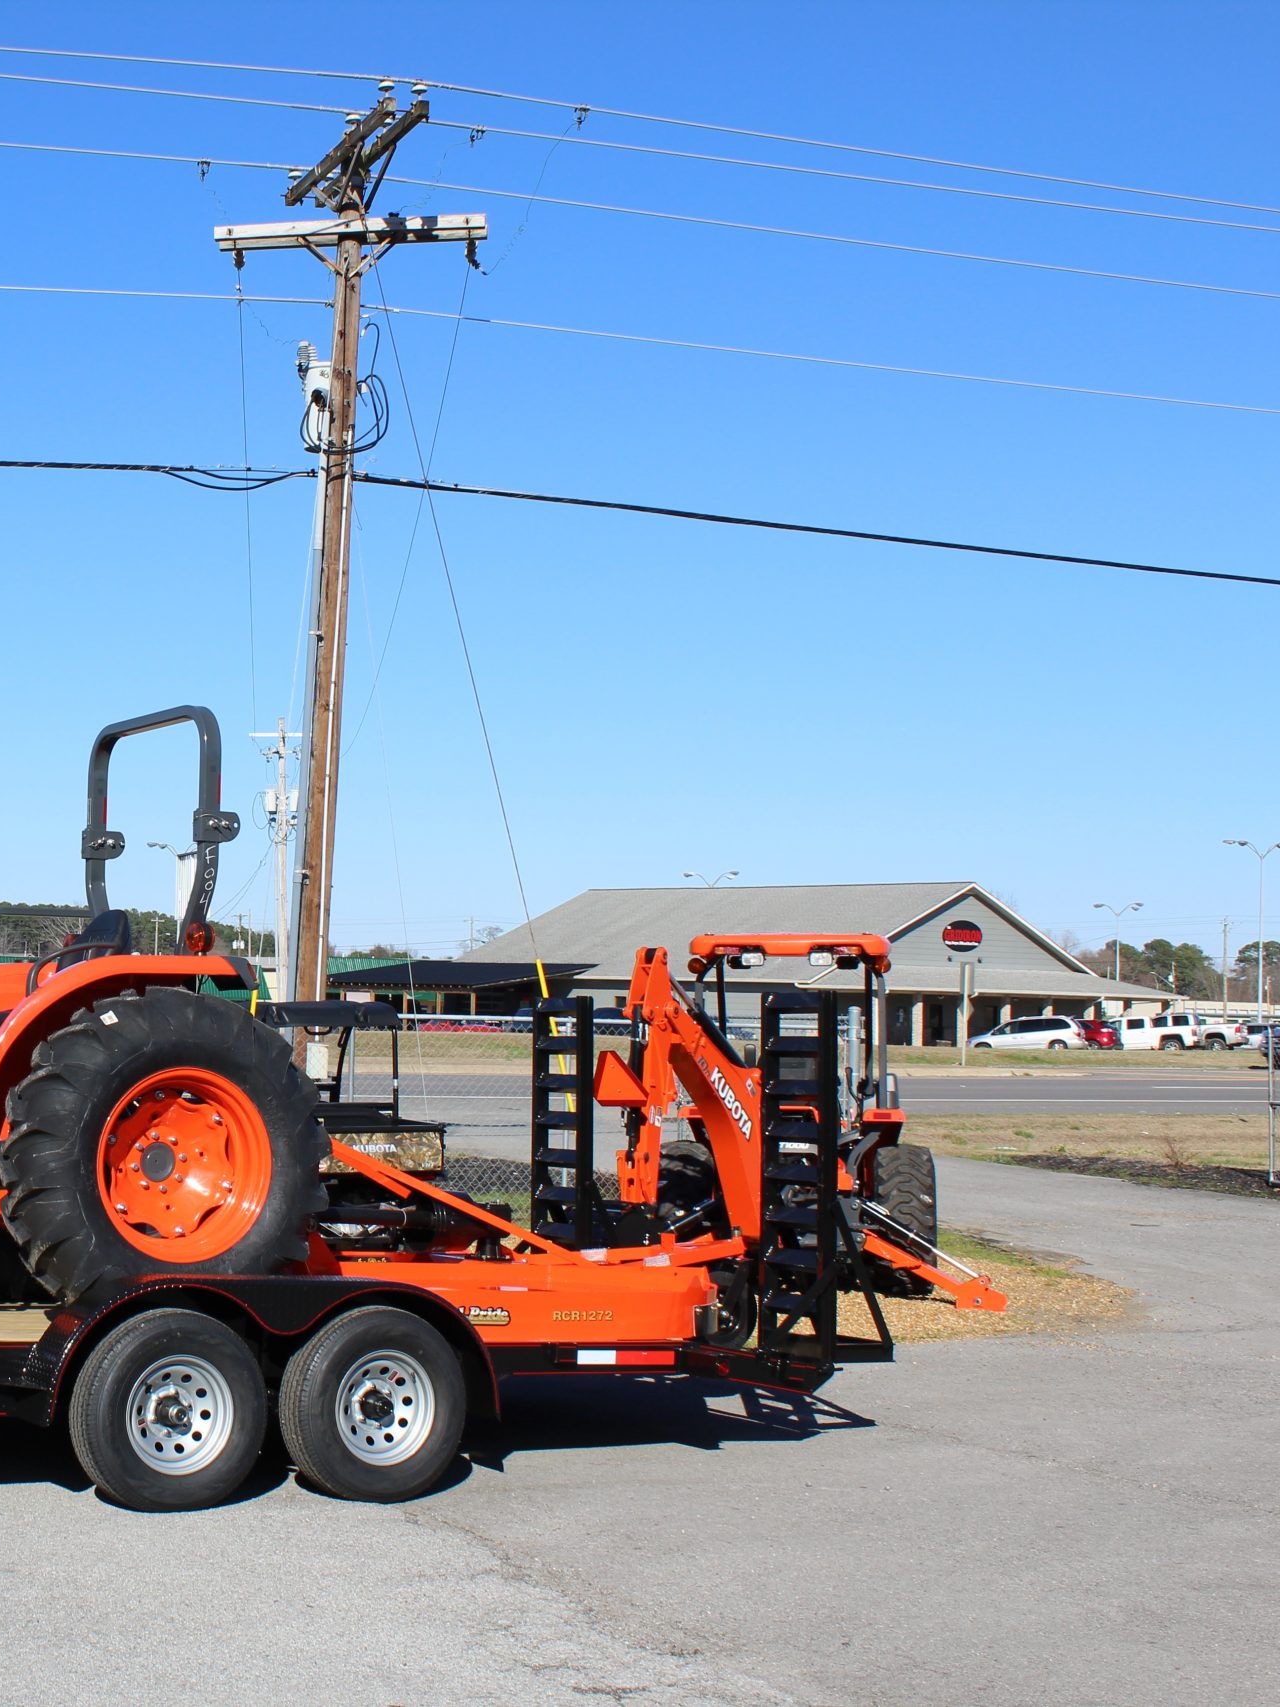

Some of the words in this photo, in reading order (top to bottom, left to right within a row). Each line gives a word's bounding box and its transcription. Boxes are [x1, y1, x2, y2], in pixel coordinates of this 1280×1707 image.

[710, 1066, 753, 1142] KUBOTA
[352, 1143, 398, 1153] KUBOTA
[552, 1310, 613, 1321] RCR1272
